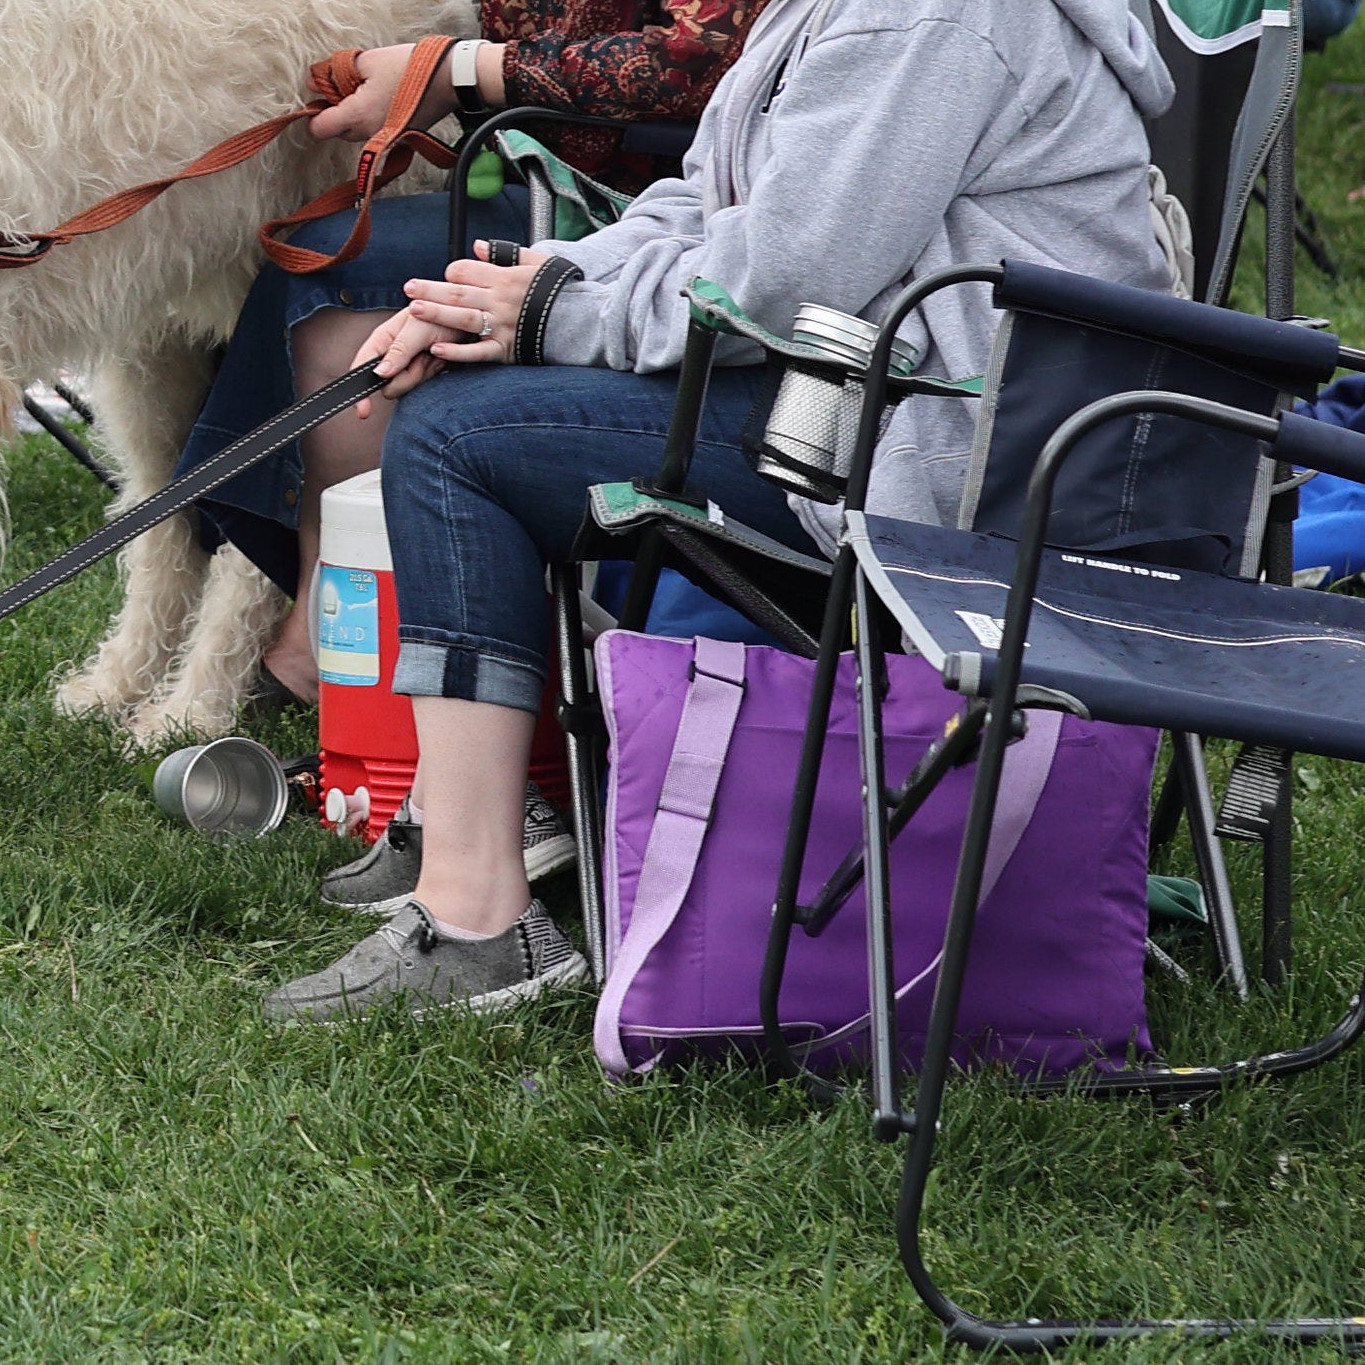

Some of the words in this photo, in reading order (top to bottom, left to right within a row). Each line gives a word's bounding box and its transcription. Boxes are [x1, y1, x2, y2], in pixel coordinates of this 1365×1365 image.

[1060, 554, 1085, 564] LIFT
[1132, 566, 1150, 576] TO
[1150, 570, 1182, 581] FOLD
